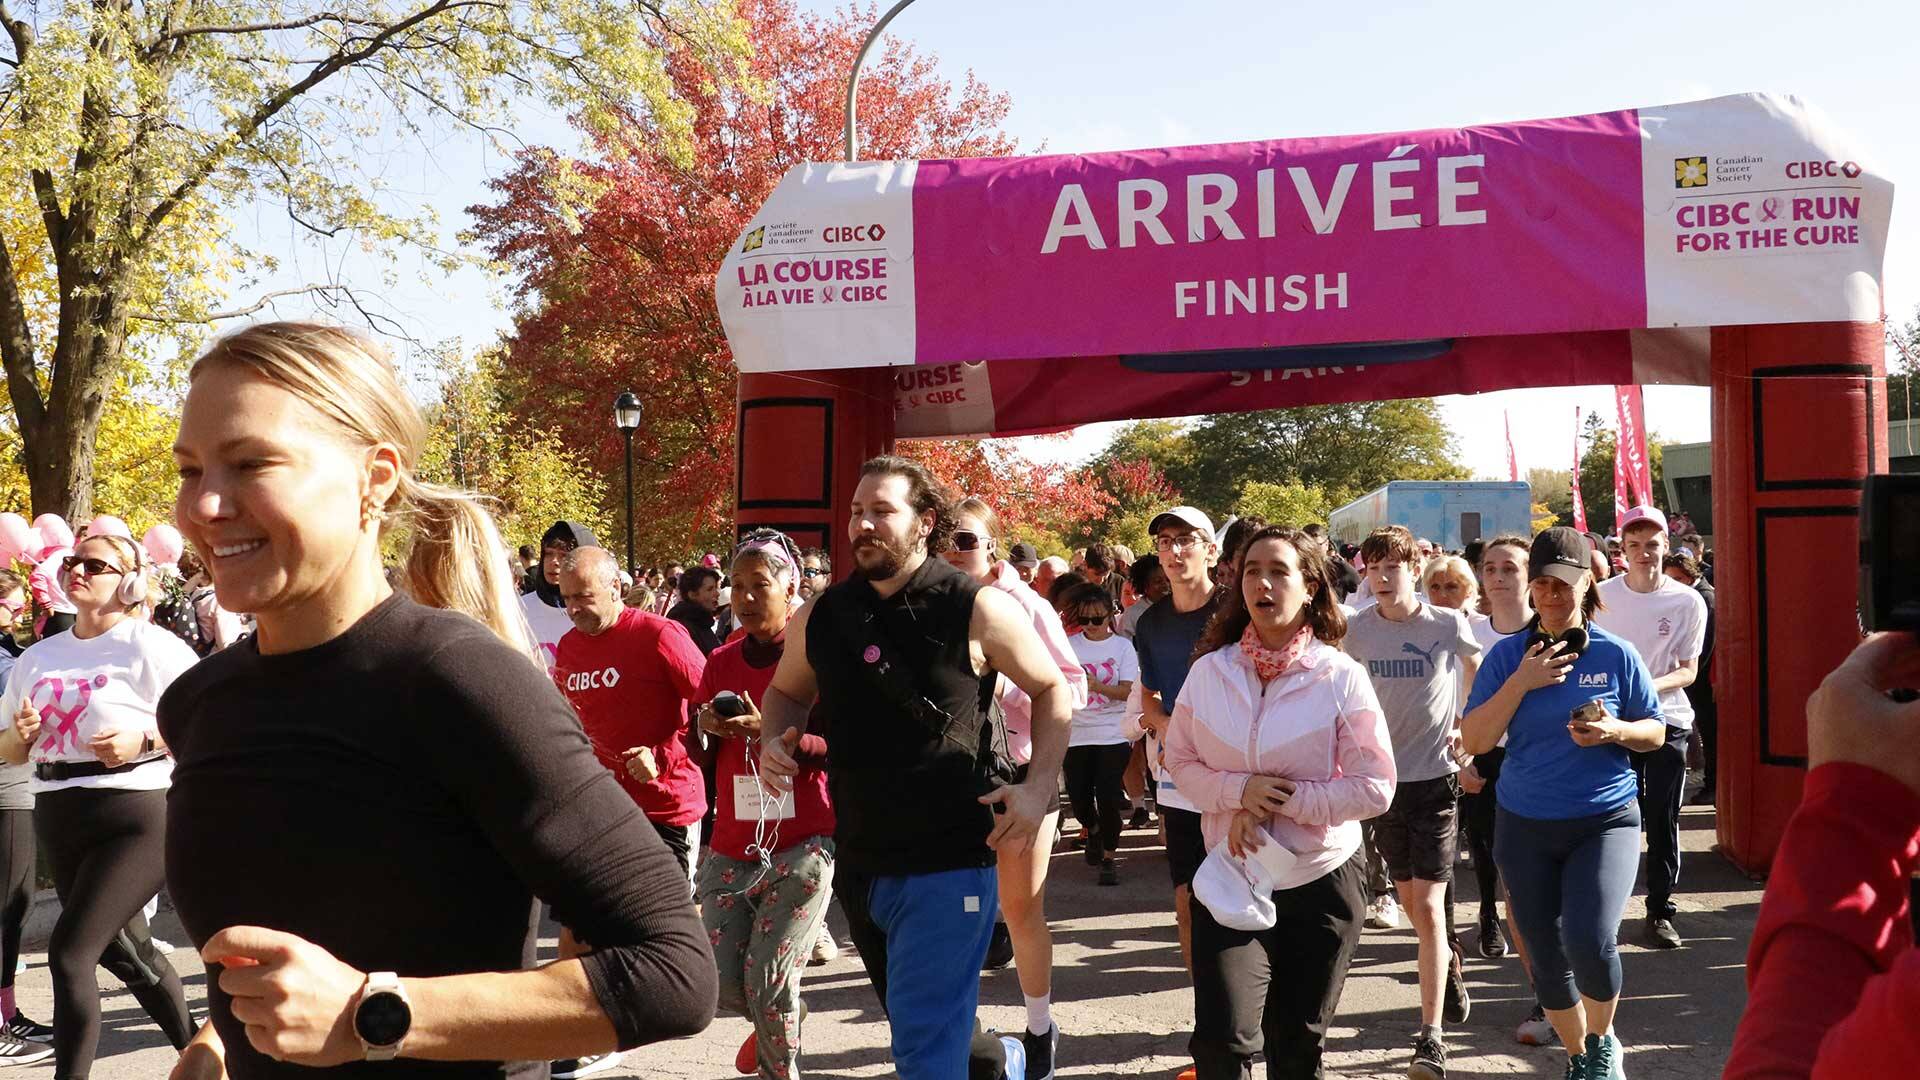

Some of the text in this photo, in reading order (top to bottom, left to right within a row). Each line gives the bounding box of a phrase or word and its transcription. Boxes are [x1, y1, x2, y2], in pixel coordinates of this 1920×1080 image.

[1715, 155, 1763, 165] Canadian
[1716, 166, 1750, 174] Cancer
[1716, 174, 1753, 183] Society
[1785, 160, 1838, 180] CIBC
[1040, 145, 1487, 254] ARRIVÉE
[1676, 196, 1860, 228] CIBC RUN
[768, 228, 814, 238] canadienne
[770, 222, 797, 230] Société
[822, 226, 865, 243] CIBC
[768, 237, 807, 245] du cancer
[1677, 225, 1859, 253] FOR THE CURE
[738, 257, 887, 287] LA COURSE
[743, 285, 887, 308] À LA VIE CIBC
[1175, 272, 1348, 318] FINISH
[896, 364, 963, 391] URSE
[926, 388, 966, 404] CIBC
[1368, 659, 1425, 678] PUMA
[567, 670, 600, 691] CIBC
